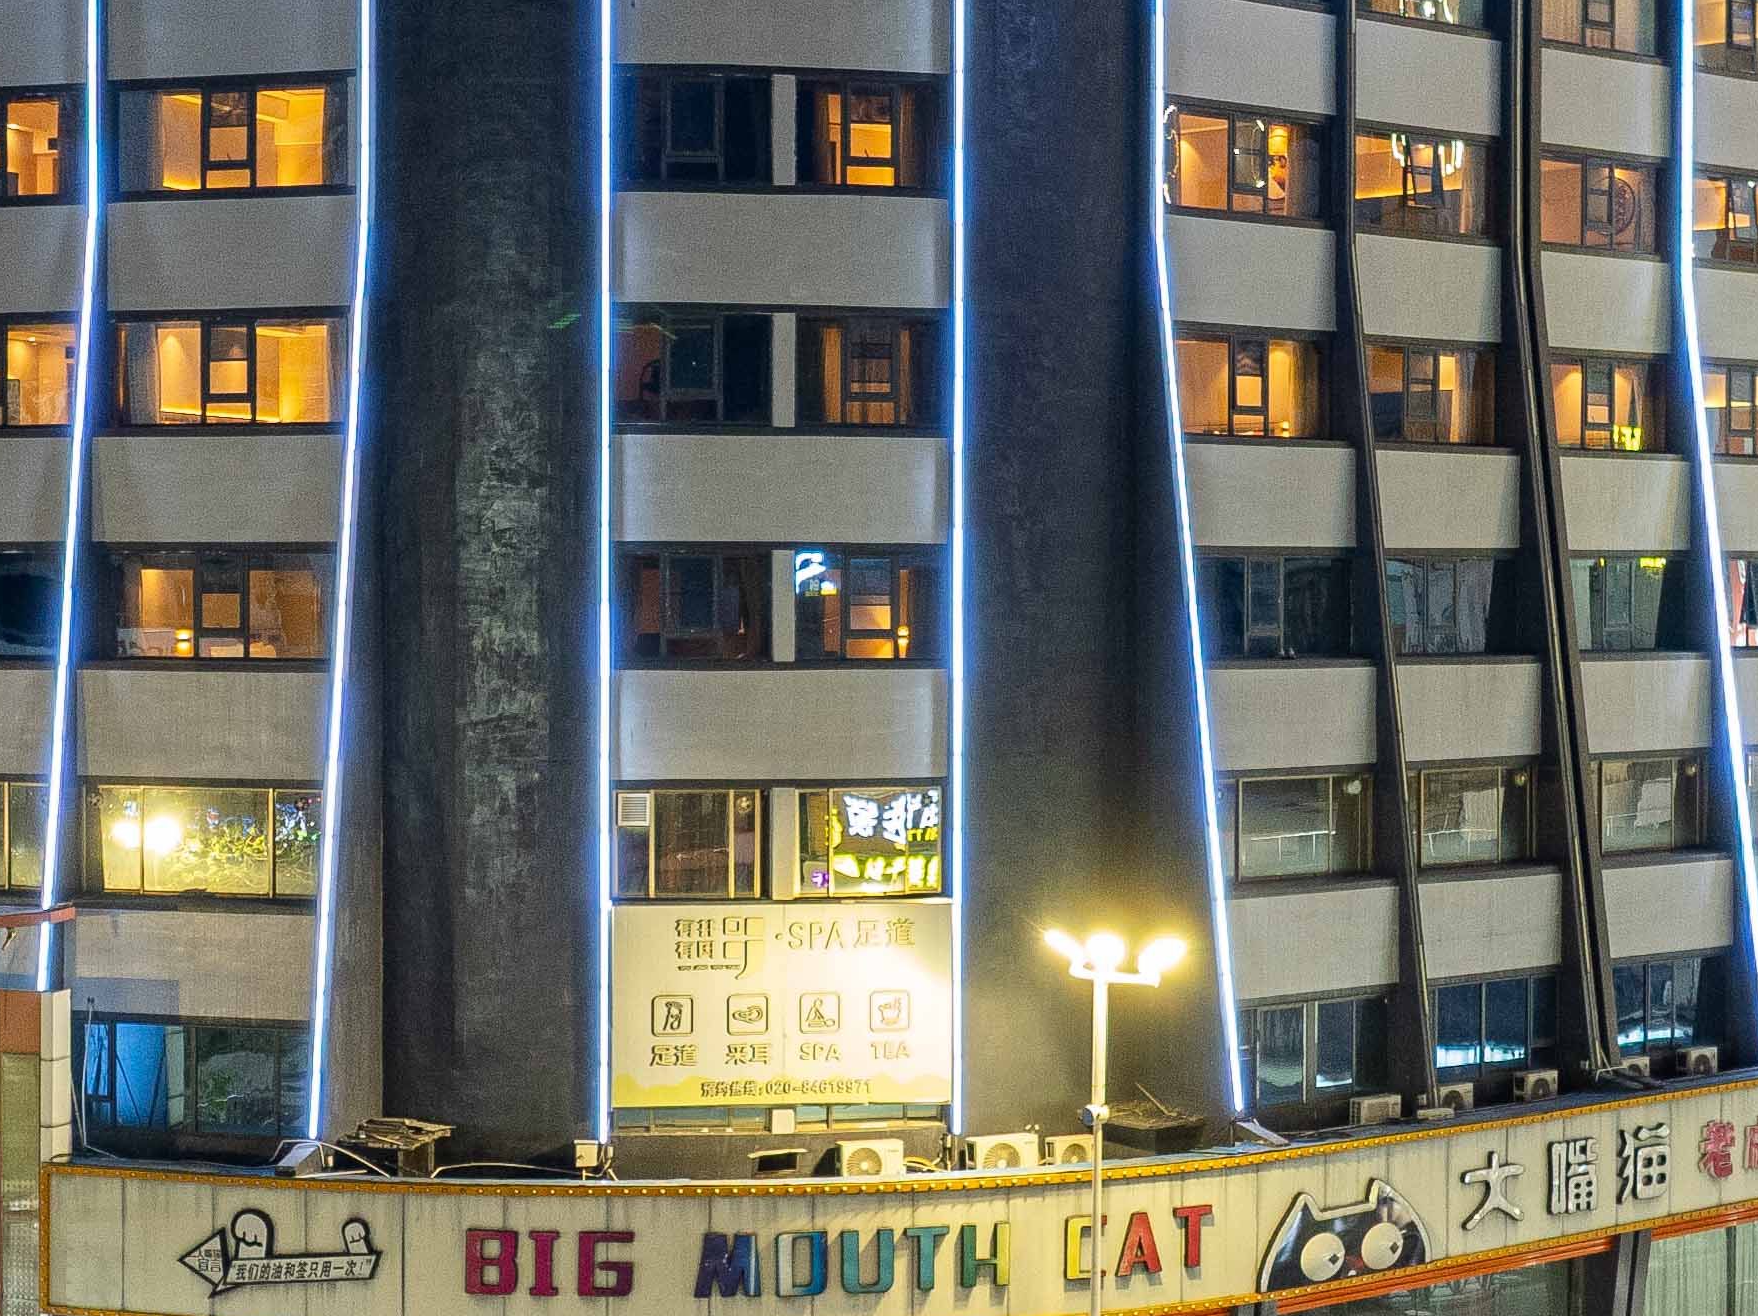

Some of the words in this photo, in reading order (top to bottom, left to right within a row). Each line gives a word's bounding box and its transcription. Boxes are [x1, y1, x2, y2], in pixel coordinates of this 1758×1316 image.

[852, 917, 916, 948] 足道
[649, 1044, 701, 1067] 足道
[724, 1043, 772, 1066] 采耳
[799, 1043, 842, 1061] SPA
[1460, 1122, 1671, 1232] 大嘴猫
[463, 1227, 636, 1298] BIG
[694, 1221, 1012, 1300] MOUTH
[1063, 1203, 1214, 1280] CAT
